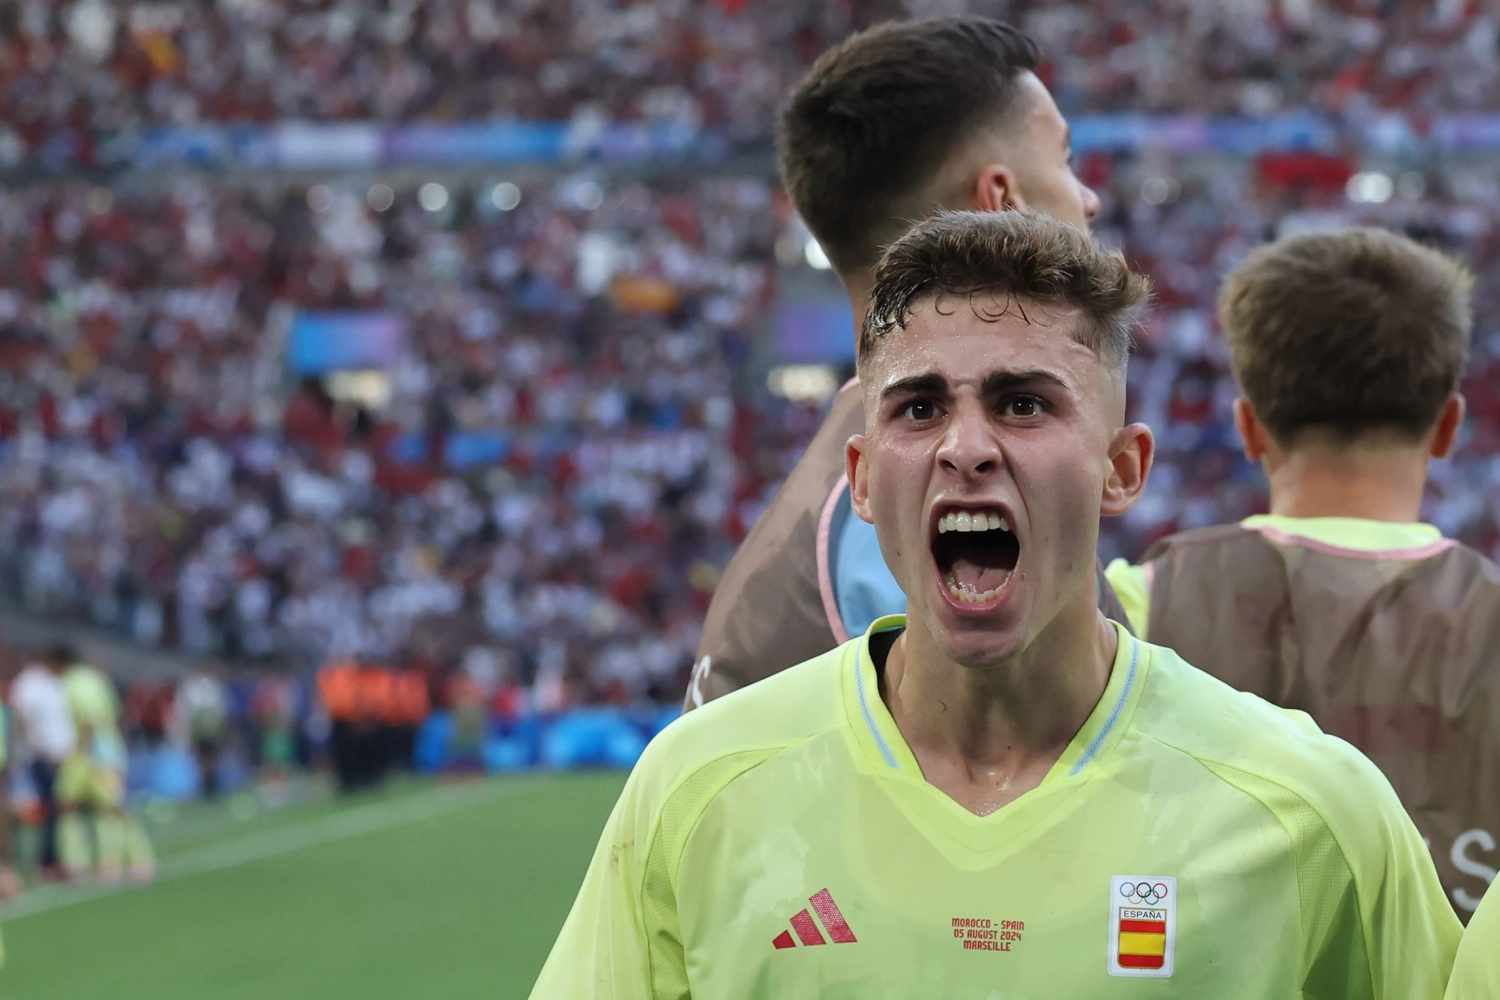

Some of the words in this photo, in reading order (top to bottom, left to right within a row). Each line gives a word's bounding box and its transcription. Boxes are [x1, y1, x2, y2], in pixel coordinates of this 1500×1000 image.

[1123, 910, 1162, 919] ESPAÑA
[951, 917, 991, 929] MOROCCO
[1001, 920, 1024, 930] SPAIN
[953, 929, 964, 938] 05
[967, 929, 998, 939] AUGUST
[1000, 931, 1022, 941] 2024
[963, 940, 1011, 952] MARSEILLE
